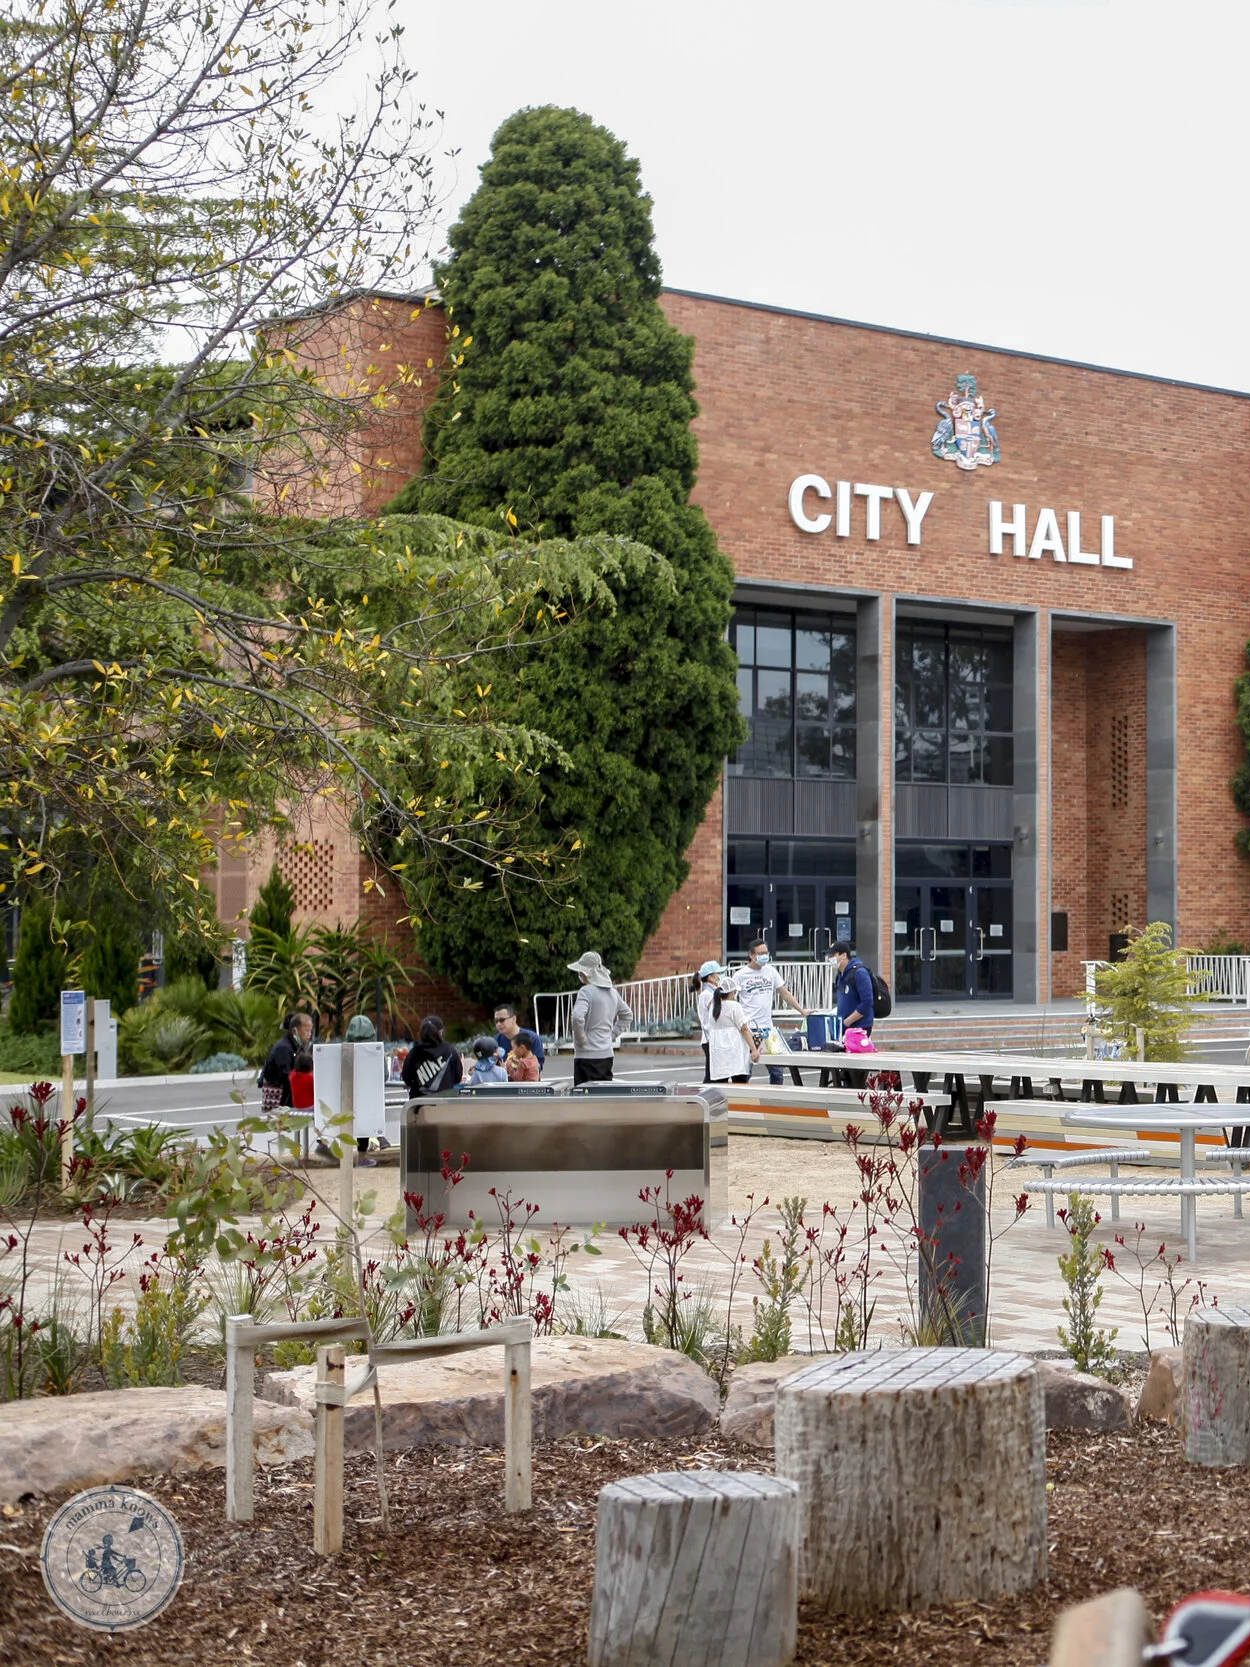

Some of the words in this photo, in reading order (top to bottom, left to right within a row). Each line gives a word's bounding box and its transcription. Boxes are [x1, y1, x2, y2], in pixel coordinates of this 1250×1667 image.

[788, 473, 934, 545] CITY
[988, 500, 1133, 569] HALL
[416, 1056, 446, 1086] NIKE
